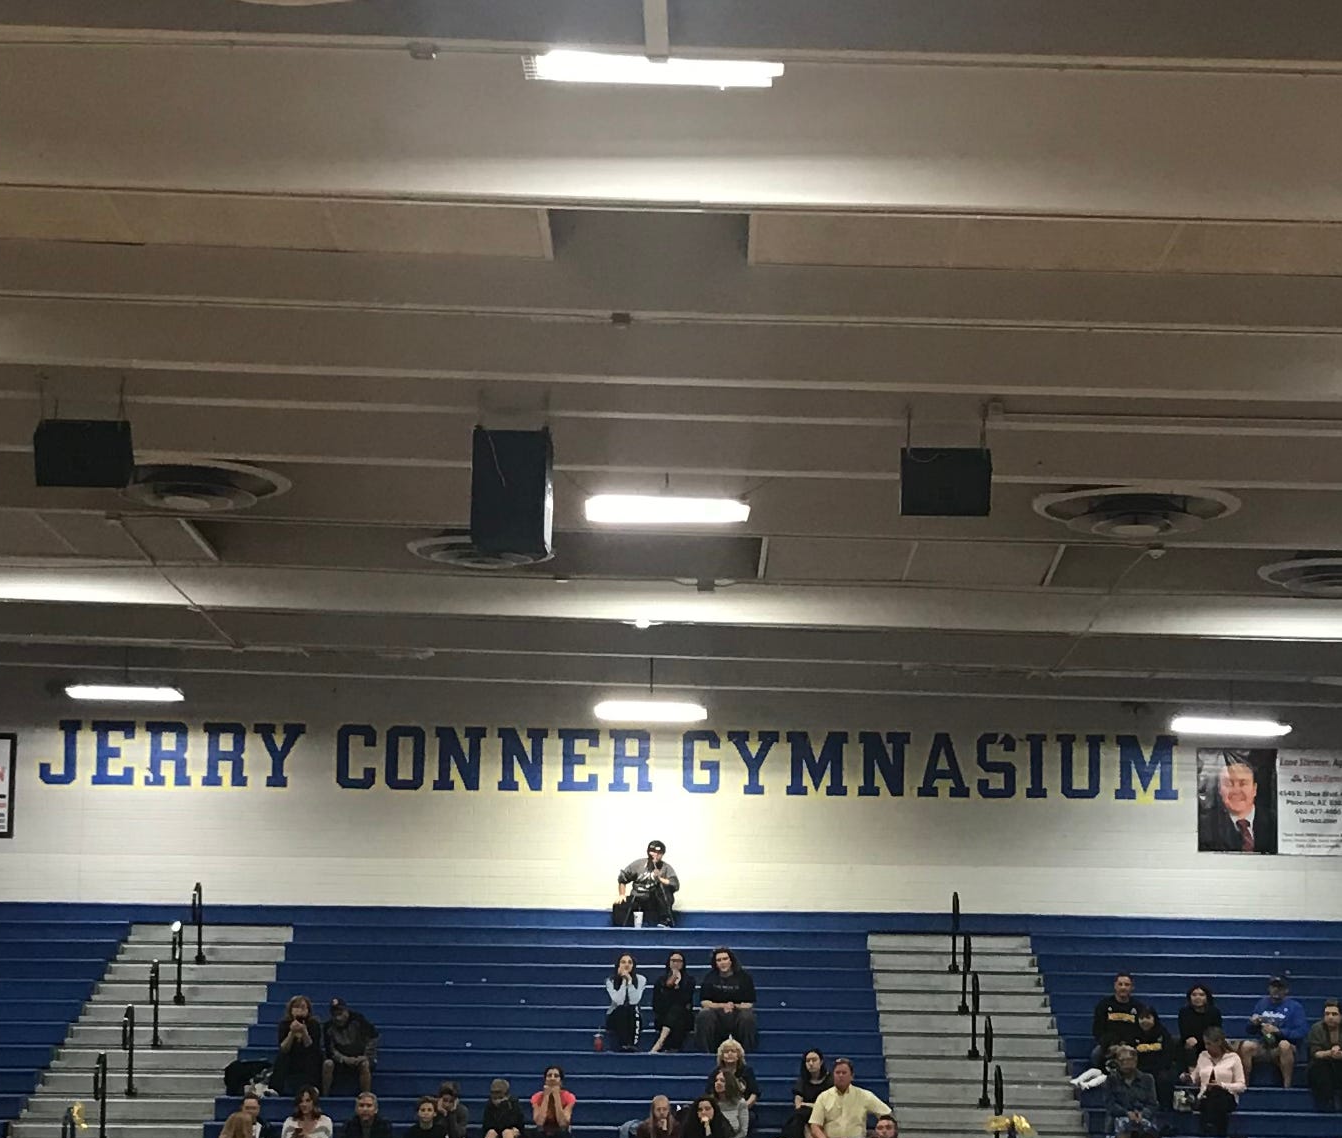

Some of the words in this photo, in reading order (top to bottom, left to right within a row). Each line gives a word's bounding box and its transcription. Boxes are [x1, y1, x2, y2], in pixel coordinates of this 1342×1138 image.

[38, 719, 307, 787] JERRY
[335, 723, 653, 792] CONNER
[682, 730, 1180, 800] GYMNASIUM
